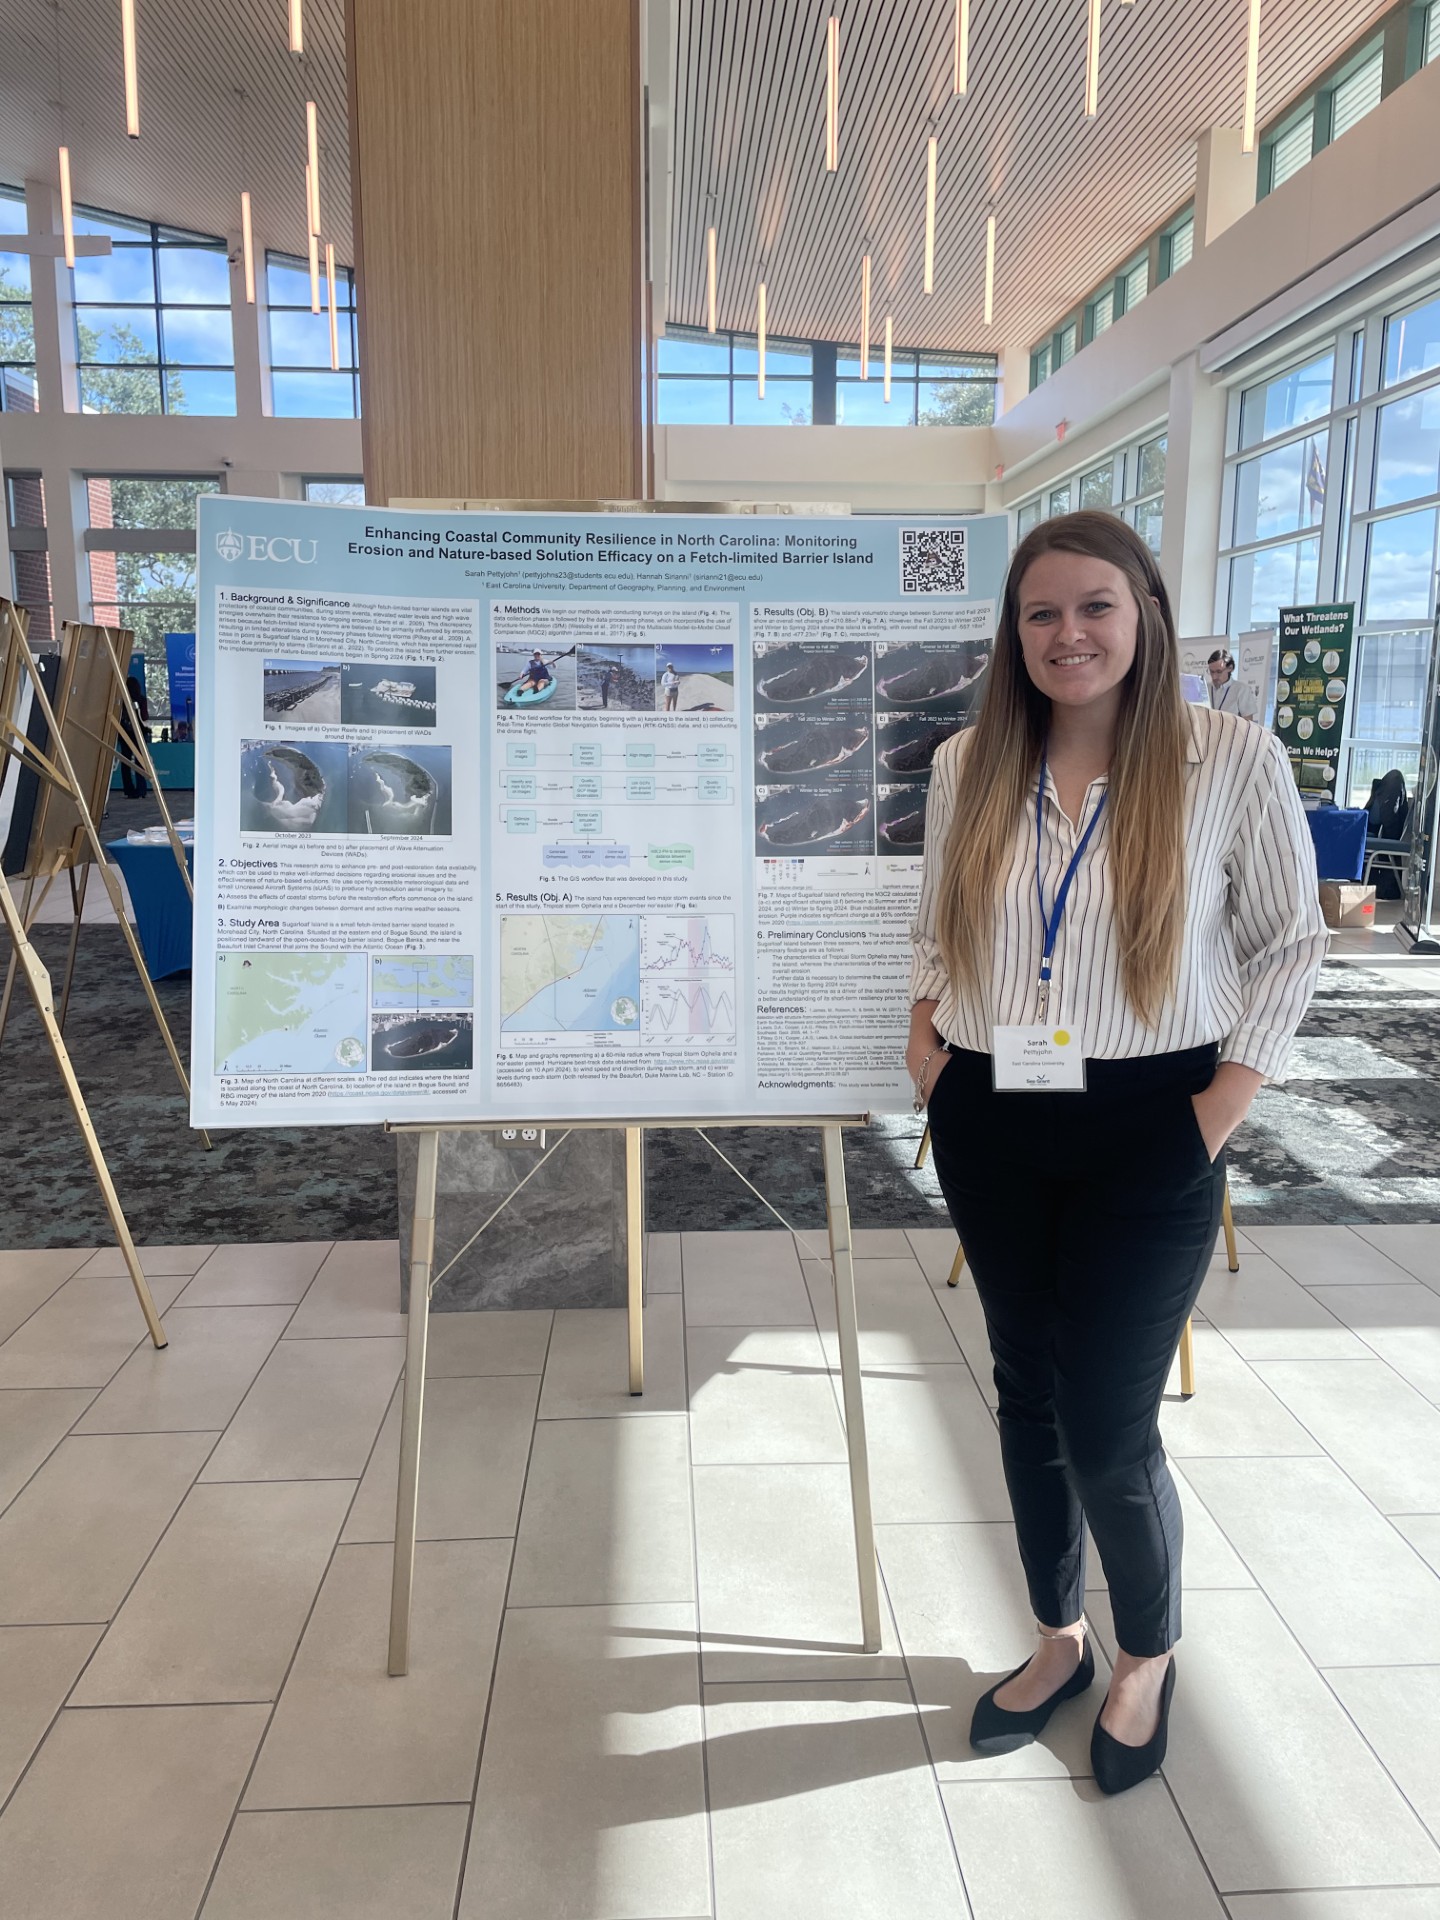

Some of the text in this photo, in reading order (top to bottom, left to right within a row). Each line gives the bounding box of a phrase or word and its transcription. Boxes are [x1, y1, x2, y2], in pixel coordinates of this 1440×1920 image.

[365, 526, 857, 549] Enhancing Coastal Community Resilience in North Carolina: Monitoring
[248, 535, 318, 563] ECU
[348, 542, 873, 565] Erosion and Nature-based Solution Efficacy on a Fetch-limited Barrier Island
[502, 581, 531, 589] Carolina
[568, 582, 607, 591] Department
[231, 593, 284, 604] Background
[296, 597, 350, 607] Significance
[797, 608, 816, 617] (Obj.
[818, 608, 828, 617] B)
[1284, 612, 1348, 623] What Threatens
[1285, 624, 1344, 635] Our Wetlands?
[1287, 746, 1338, 758] Can We Help?
[218, 859, 277, 869] 2. Objectives
[540, 893, 561, 902] (Obj.
[563, 893, 572, 902] A)
[218, 919, 226, 927] 3.
[229, 919, 256, 929] Study
[768, 931, 814, 940] Preliminary
[758, 1081, 836, 1089] Acknowledgments:
